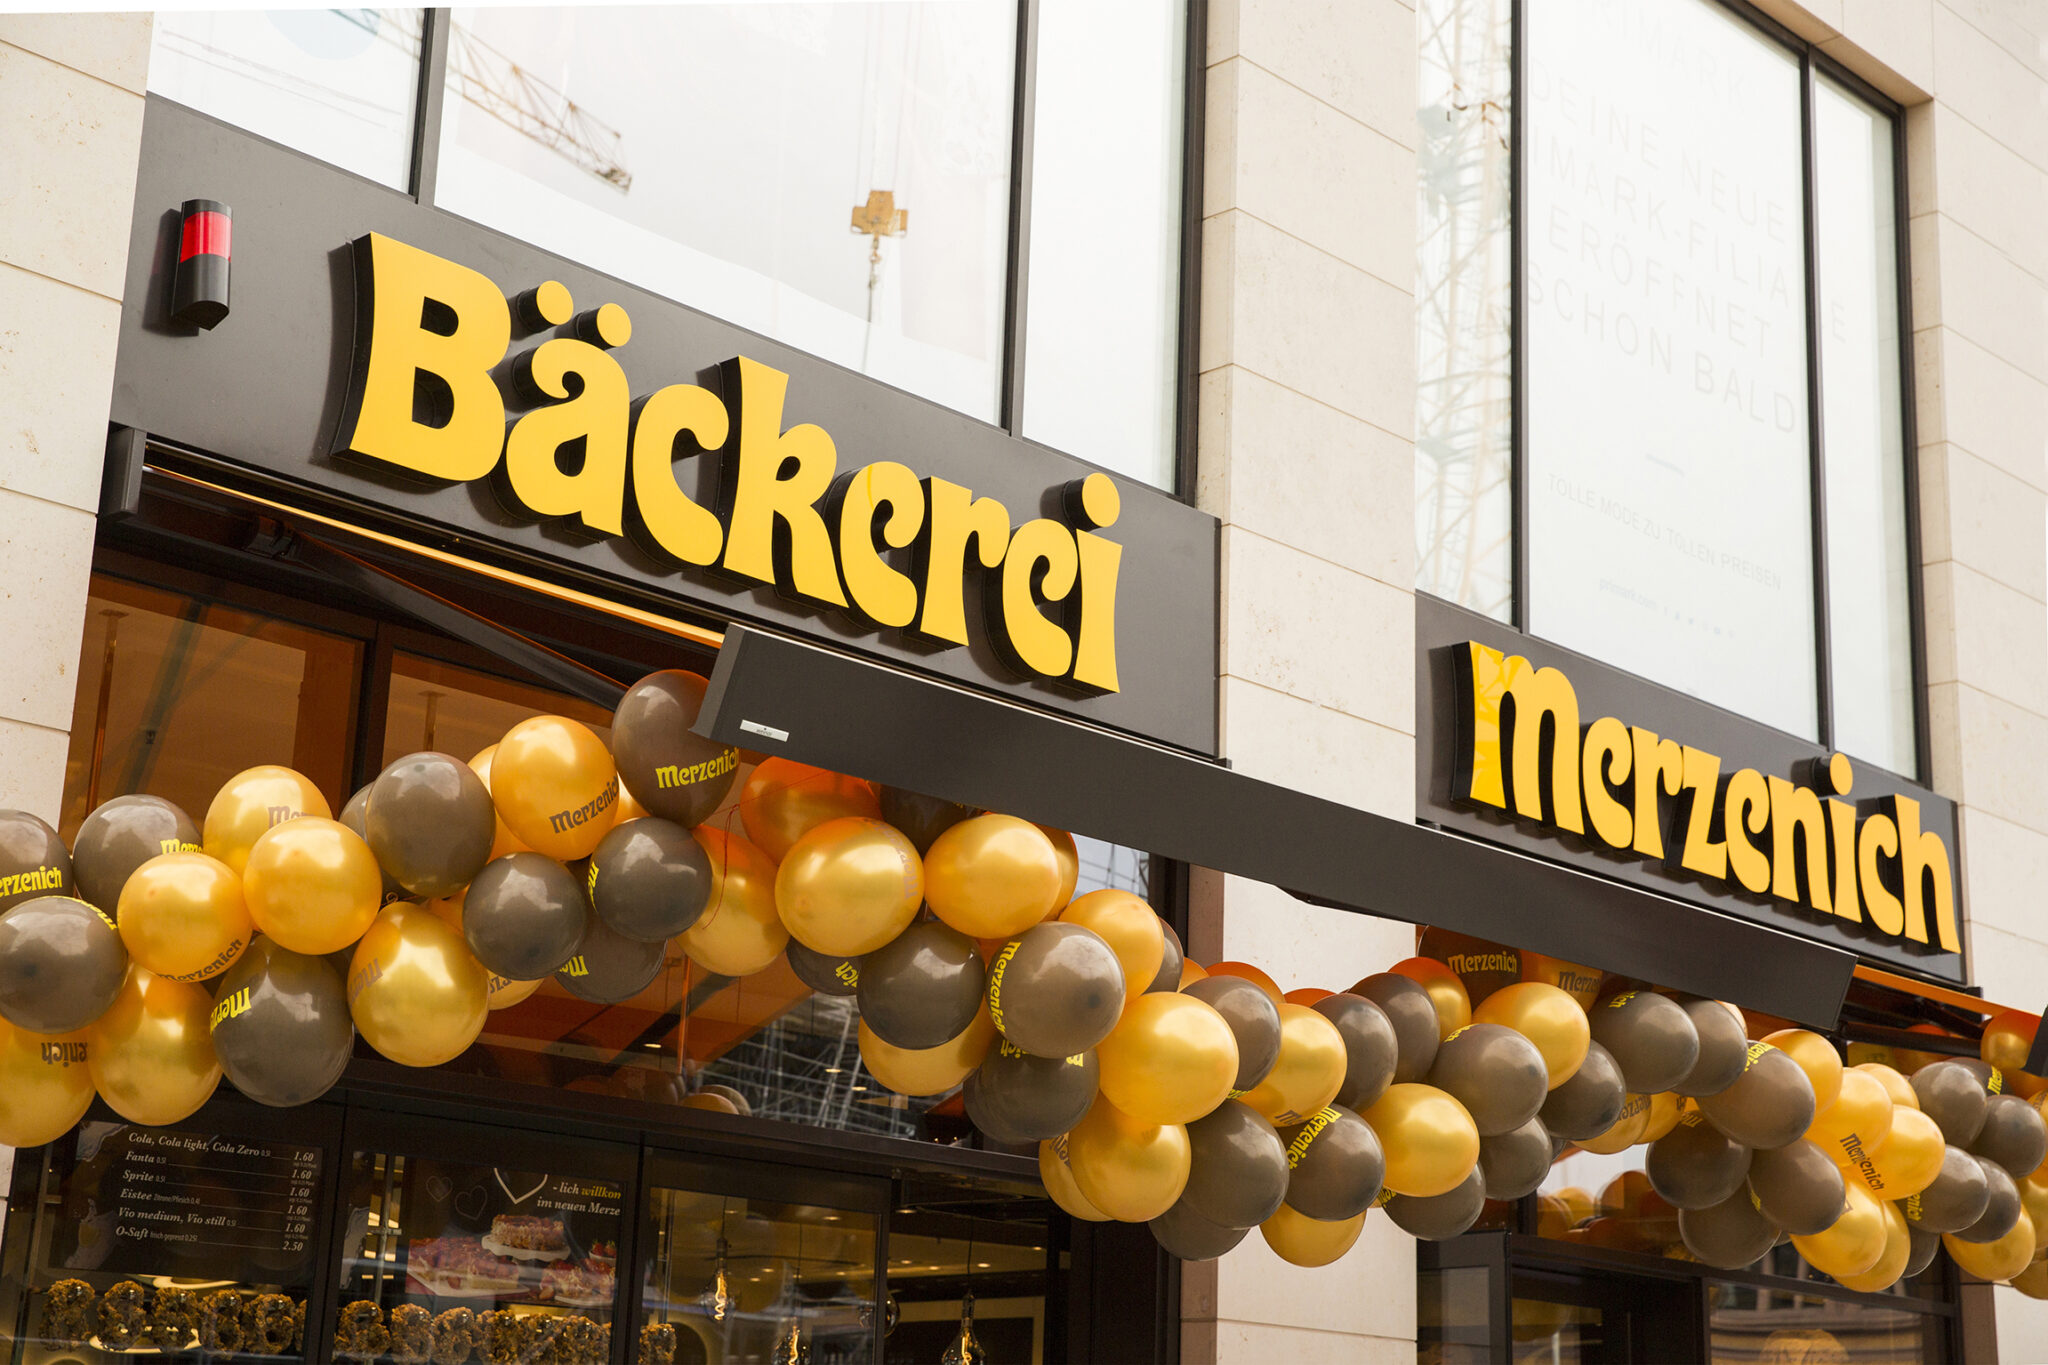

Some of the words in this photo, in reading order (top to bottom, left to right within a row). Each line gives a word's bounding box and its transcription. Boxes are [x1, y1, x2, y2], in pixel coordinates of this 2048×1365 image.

[1531, 55, 1660, 171] DEINE
[1681, 146, 1786, 244] NEUE
[1550, 204, 1772, 359] ERÖFFNET
[1529, 259, 1673, 375] SCHON
[1695, 351, 1796, 434] BALD
[349, 232, 1123, 695] Bäckerei
[1547, 472, 1597, 510] TOLLE
[158, 1135, 181, 1149] Cola
[212, 1142, 235, 1154] Cola
[236, 1144, 260, 1157] Zero
[294, 1151, 315, 1162] 1.60
[125, 1150, 155, 1164] Fanta
[291, 1169, 313, 1180] 1.60
[122, 1169, 154, 1183] Sprite
[289, 1187, 310, 1198] 1.60
[120, 1188, 153, 1200] Eistee
[287, 1205, 308, 1216] 1.60
[554, 1201, 587, 1213] neuen
[118, 1206, 136, 1218] Vio
[187, 1213, 204, 1225] Vio
[205, 1215, 227, 1227] still
[285, 1223, 306, 1234] 1.60
[115, 1225, 149, 1240] O-Saft
[282, 1240, 304, 1252] 2.50
